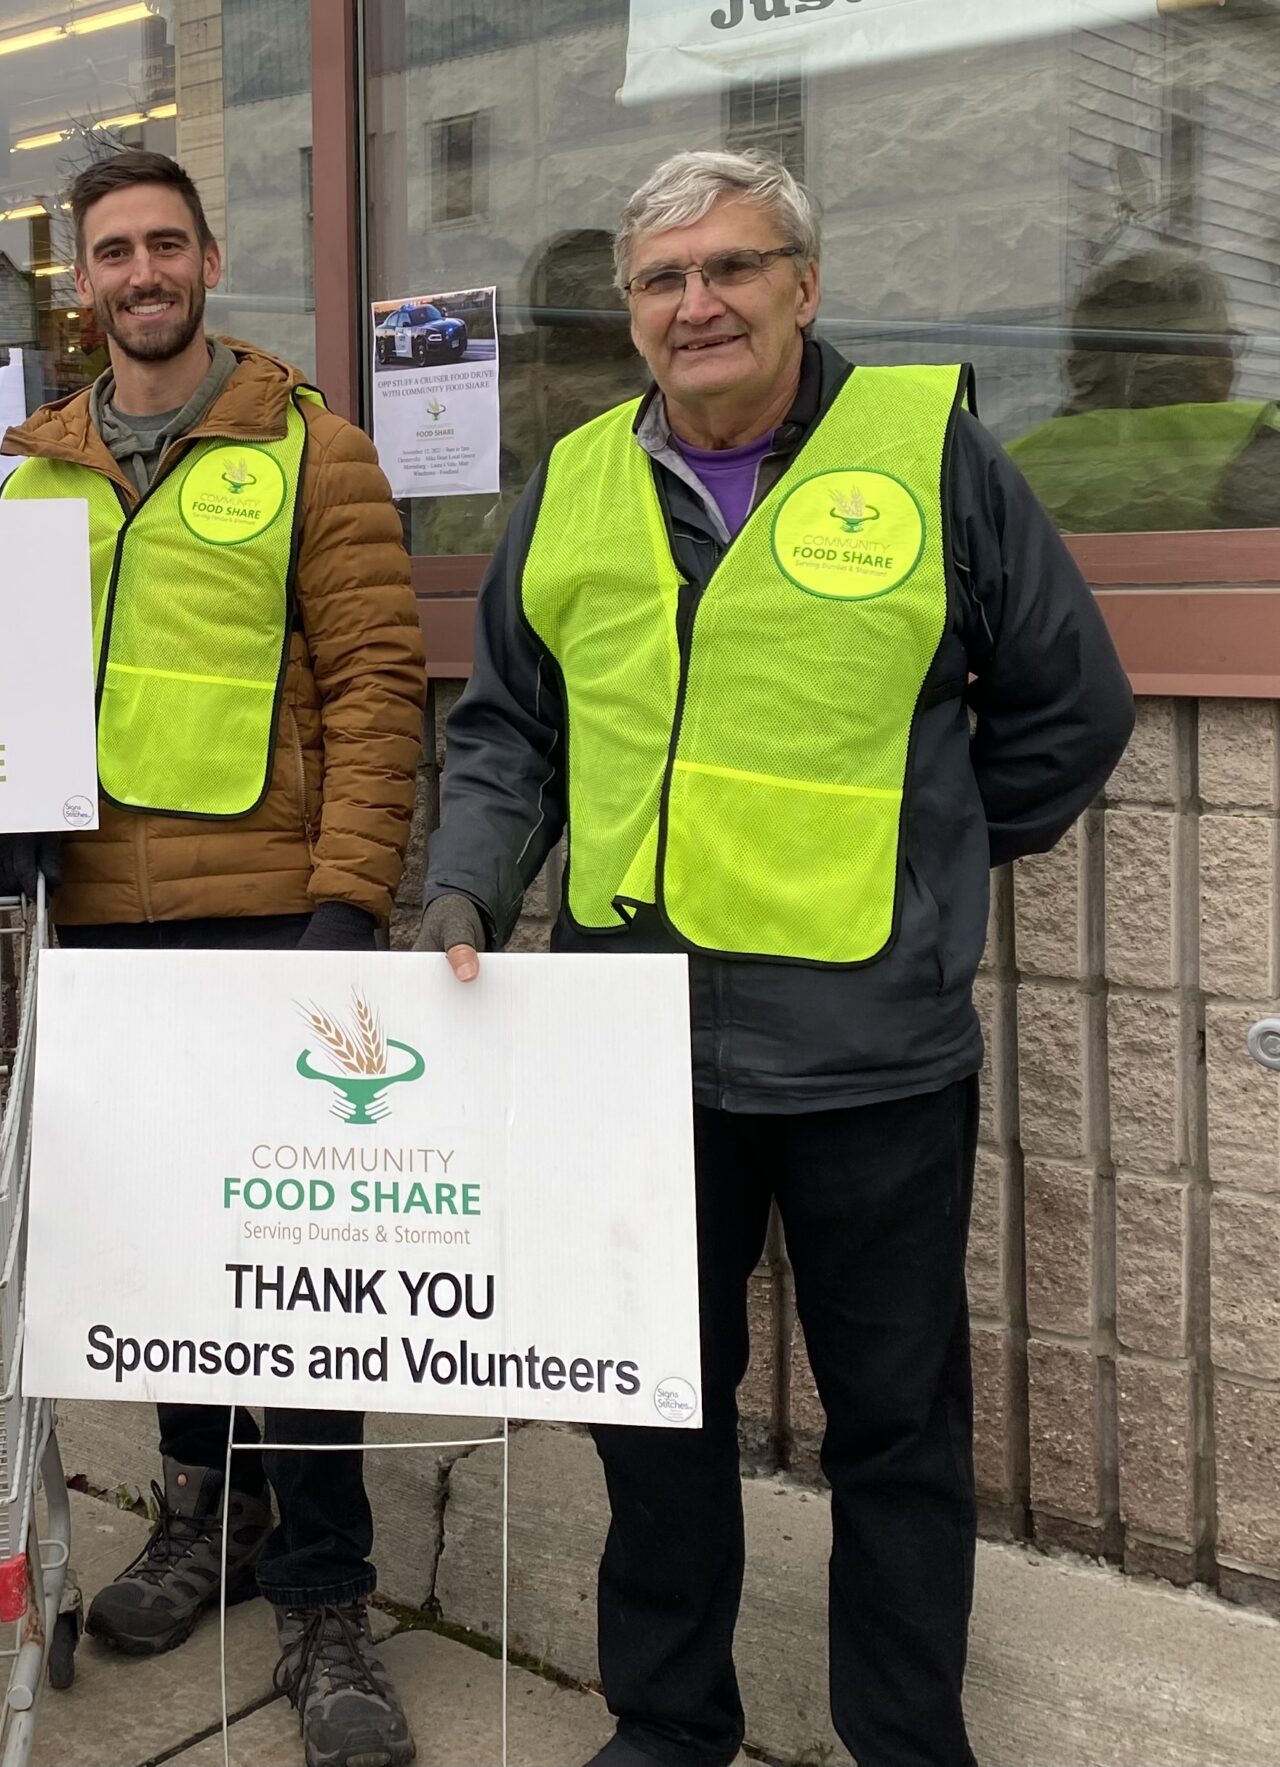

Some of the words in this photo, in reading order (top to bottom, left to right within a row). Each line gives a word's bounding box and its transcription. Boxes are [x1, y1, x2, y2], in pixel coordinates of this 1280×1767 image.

[710, 0, 862, 29] Jus
[382, 390, 400, 398] WITH
[402, 386, 444, 396] COMMUNITY
[446, 384, 464, 392] FOOD
[466, 381, 490, 390] SHARE
[393, 379, 412, 387] STUFF
[420, 375, 448, 384] CRUISER
[471, 370, 494, 379] DRIVE
[192, 502, 223, 514] FOOD
[226, 507, 261, 520] SHARE
[802, 535, 892, 553] COMMUNITY
[792, 546, 837, 560] FOOD
[842, 551, 894, 569] SHARE
[252, 1144, 454, 1174] COMMUNITY
[224, 1177, 335, 1211] FOOD
[350, 1180, 481, 1215] SHARE
[244, 1221, 302, 1244] Serving
[309, 1222, 369, 1242] Dundas
[375, 1225, 387, 1243] &
[395, 1225, 470, 1245] Stormont
[225, 1264, 386, 1314] THANK
[397, 1270, 494, 1320] YOU
[86, 1324, 294, 1383] Sponsors
[305, 1336, 388, 1383] and
[401, 1337, 641, 1396] Volunteers
[657, 1388, 679, 1399] Signs
